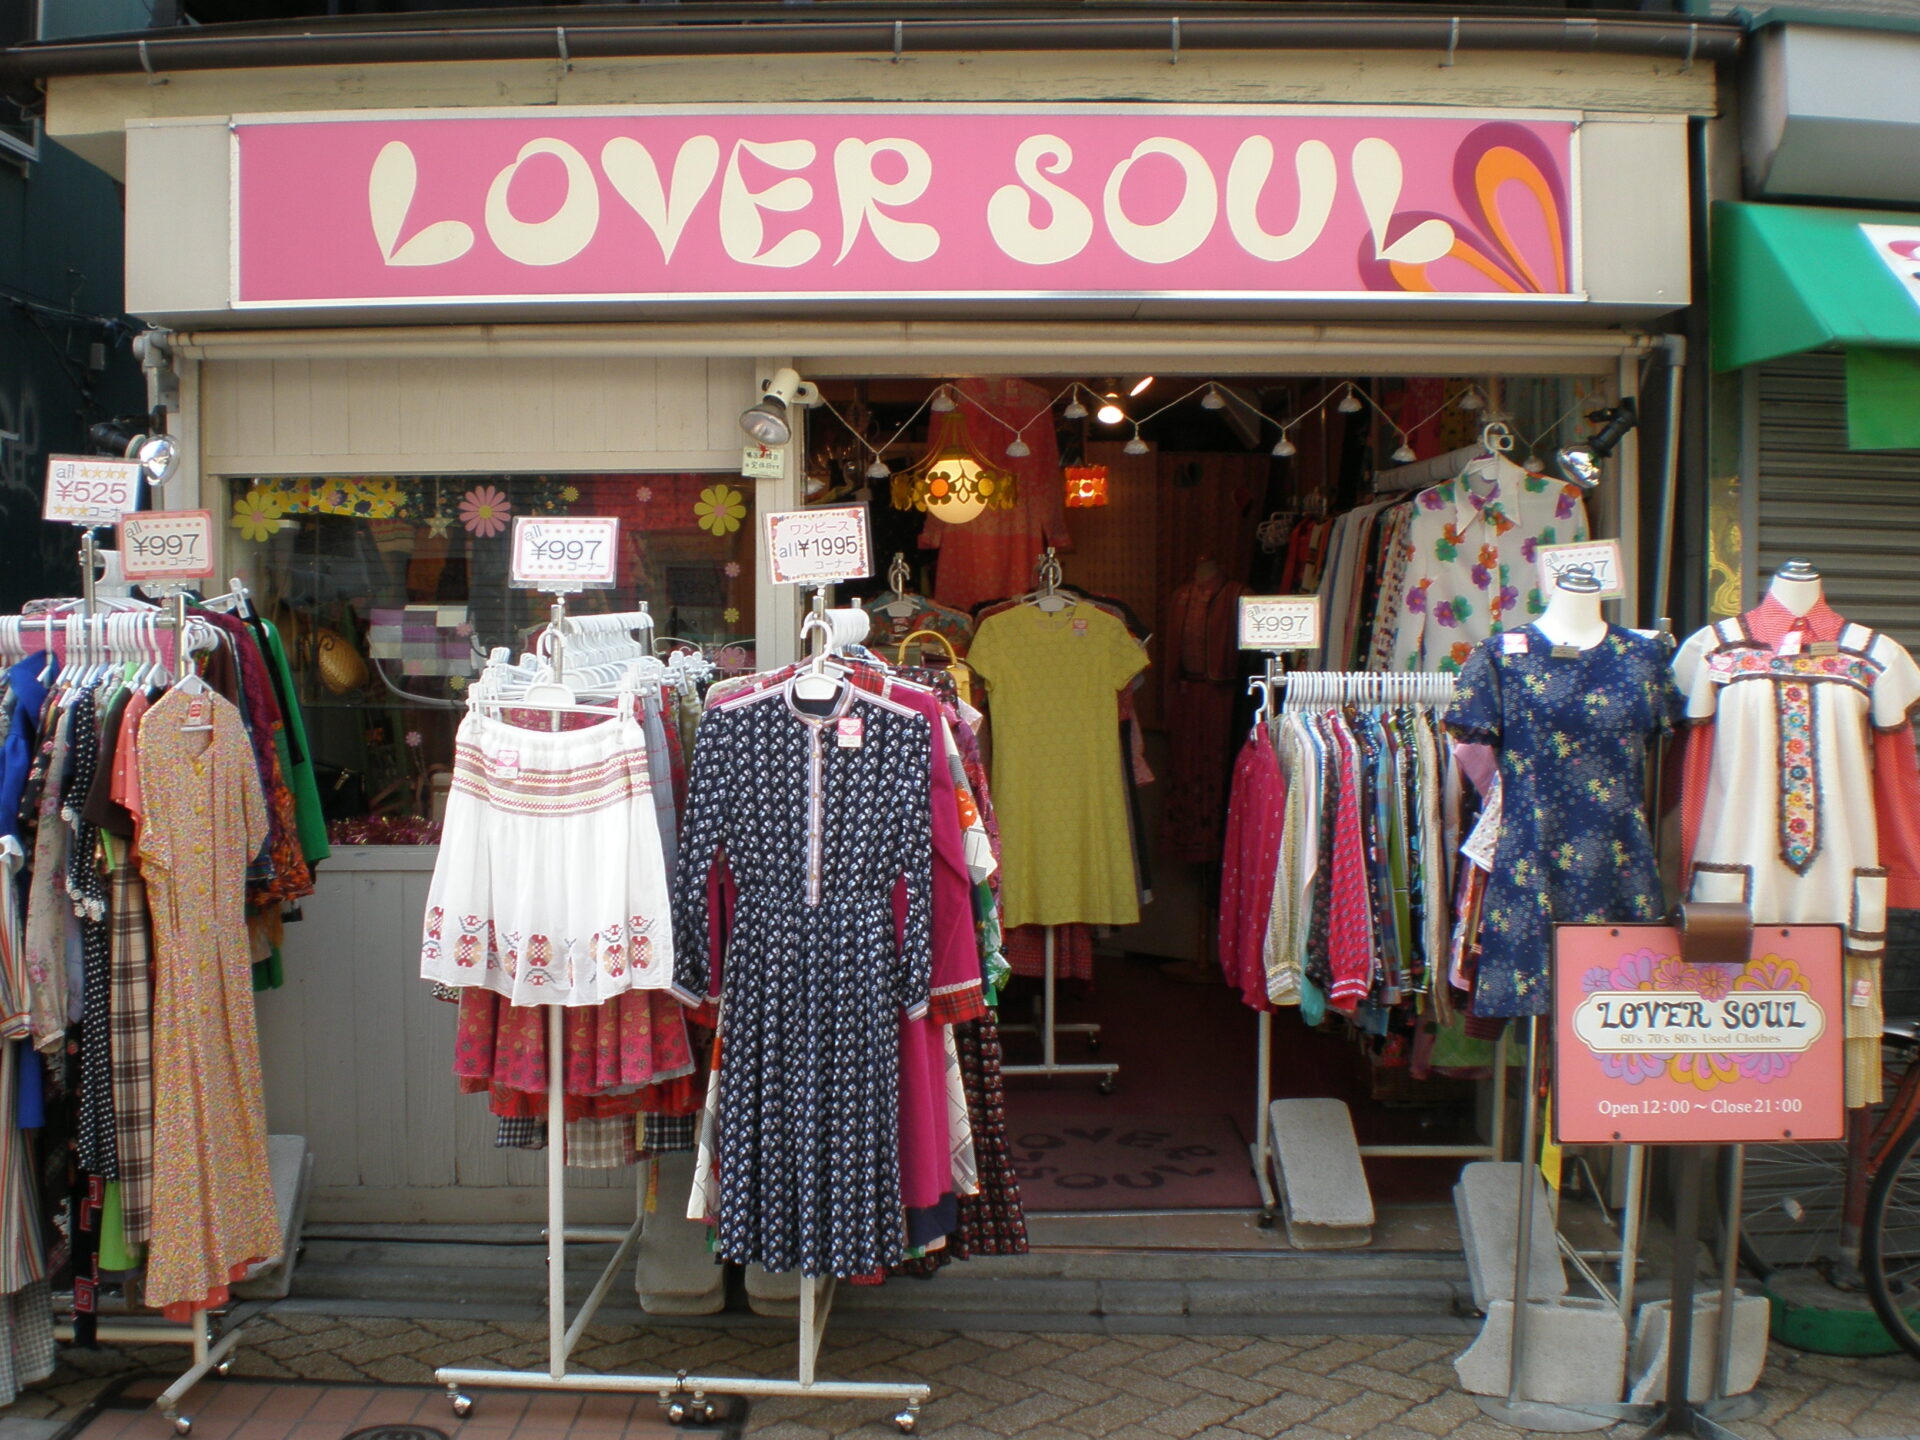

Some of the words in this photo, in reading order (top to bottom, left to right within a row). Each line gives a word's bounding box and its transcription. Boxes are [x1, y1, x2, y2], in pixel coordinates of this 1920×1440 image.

[369, 135, 940, 267] LOVER
[987, 134, 1455, 264] SOUL
[56, 464, 75, 479] all
[56, 480, 127, 504] ¥525
[89, 507, 122, 518] コーナ
[125, 521, 143, 538] all
[524, 525, 542, 541] all
[790, 520, 849, 536] ワンピース
[132, 533, 200, 556] ¥997
[530, 540, 602, 560] ¥997
[1252, 615, 1308, 632] ¥997
[1597, 1000, 1711, 1029] LOVER
[1721, 1000, 1806, 1030] SOUL
[1620, 1033, 1643, 1044] 60's
[1648, 1033, 1670, 1044] 70's
[1673, 1033, 1697, 1044] 80's
[1702, 1033, 1732, 1044] Used
[1735, 1032, 1781, 1044] Clothes
[1598, 1100, 1639, 1117] Open
[1642, 1099, 1690, 1114] 12:00
[1711, 1099, 1752, 1113] Close
[1754, 1098, 1802, 1113] 21:00
